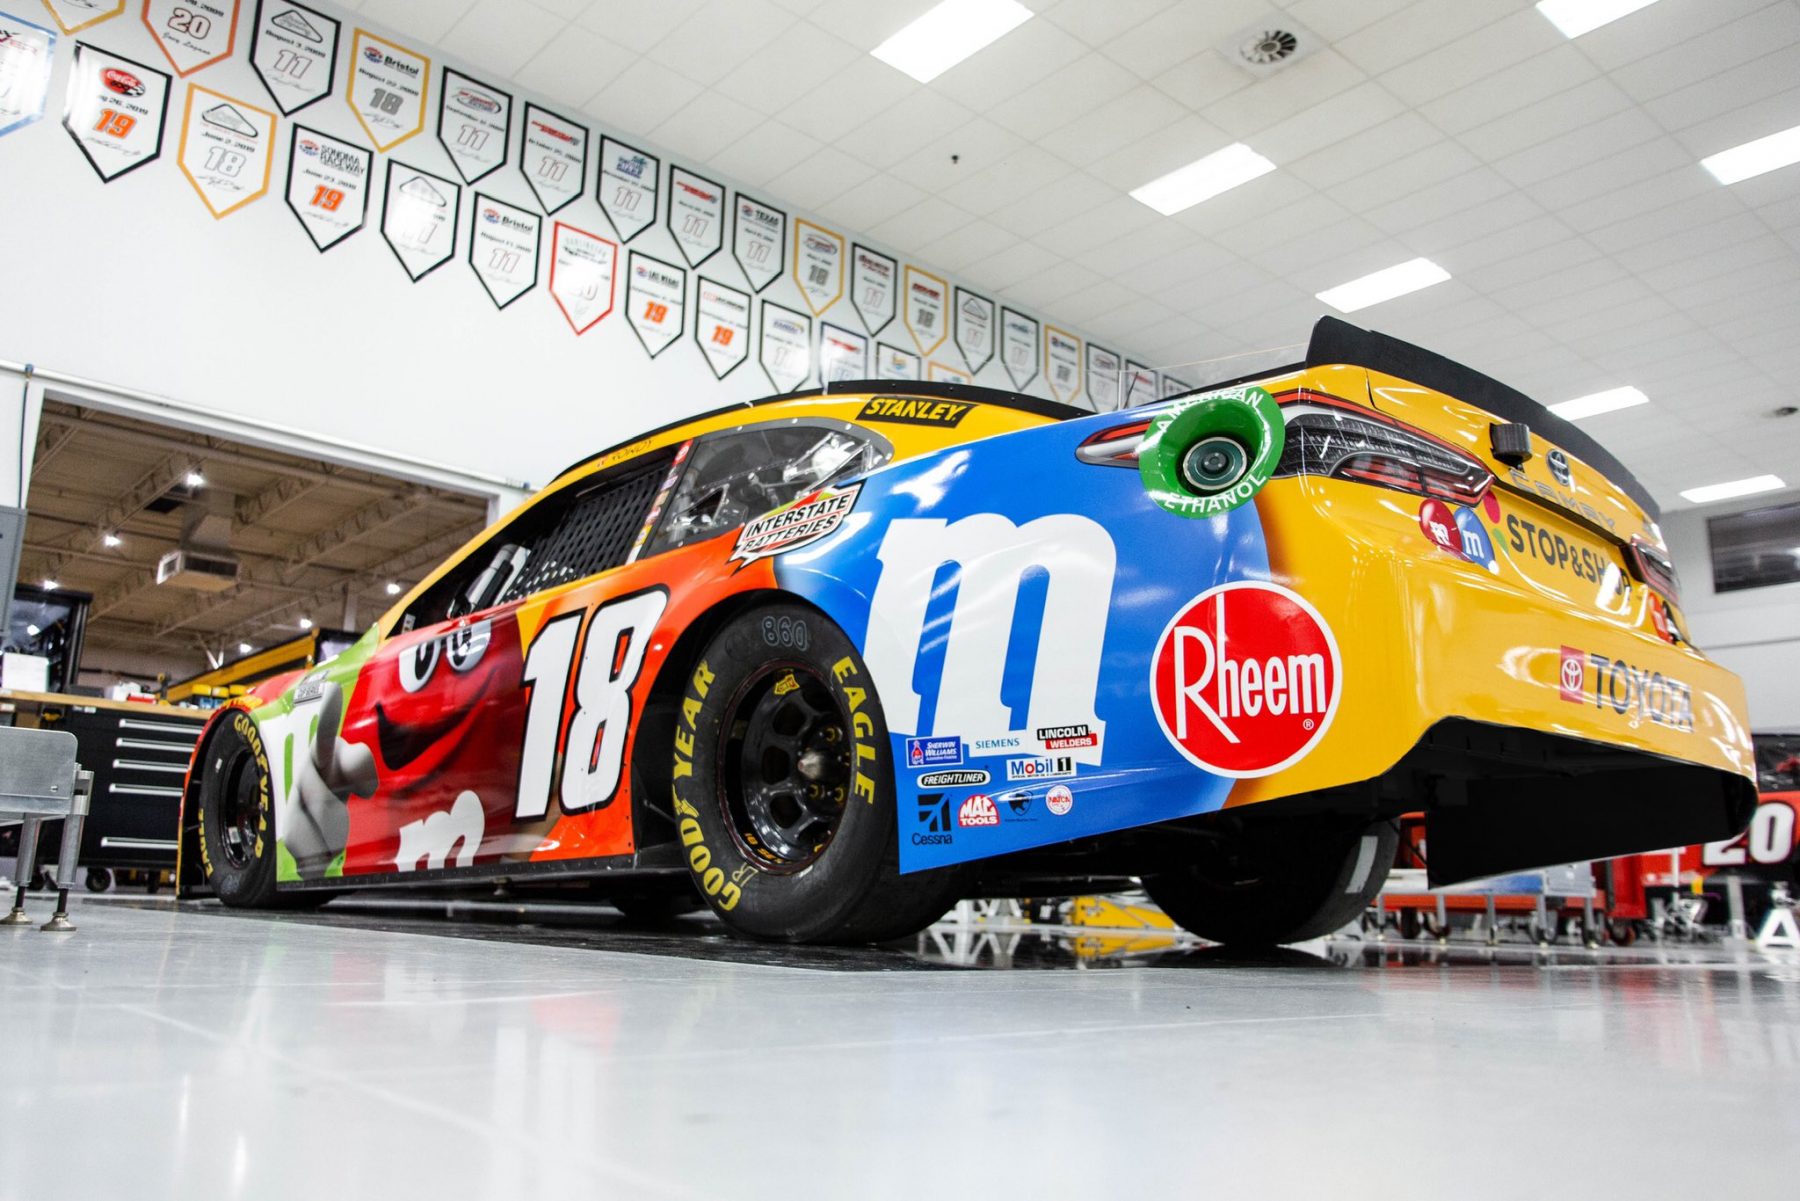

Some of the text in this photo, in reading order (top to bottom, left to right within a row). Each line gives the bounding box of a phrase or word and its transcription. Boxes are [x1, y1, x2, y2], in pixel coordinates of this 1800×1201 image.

[167, 7, 211, 40] 20
[273, 48, 313, 79] 11
[384, 55, 419, 75] Bristol
[370, 88, 403, 119] 18
[96, 109, 135, 138] 19
[457, 123, 490, 151] 11
[204, 145, 247, 178] 18
[538, 155, 569, 182] 11
[312, 185, 343, 211] 19
[502, 216, 533, 231] Bristol
[754, 208, 780, 228] TEXAS
[644, 302, 668, 323] 19
[864, 396, 967, 422] STANLEY
[1163, 473, 1267, 514] ETHANOL
[746, 494, 849, 538] INTERSTATE
[742, 514, 838, 552] BATTERIES
[1462, 529, 1485, 559] m
[1174, 592, 1327, 744] Rheem
[512, 583, 671, 825] 18
[1591, 653, 1695, 733] TOYOTA
[832, 655, 876, 806] EAGLE
[975, 738, 1020, 749] SIEMENS
[1039, 726, 1087, 740] LINCOLN
[925, 748, 958, 757] WILLIAMS
[926, 741, 957, 750] SHERWIN
[1049, 738, 1092, 750] WELDERS
[923, 774, 984, 785] FREIGHTLINER
[1011, 758, 1053, 775] Mobil
[960, 796, 996, 818] MAC
[960, 816, 999, 826] TOOLS
[912, 833, 953, 845] Cessna
